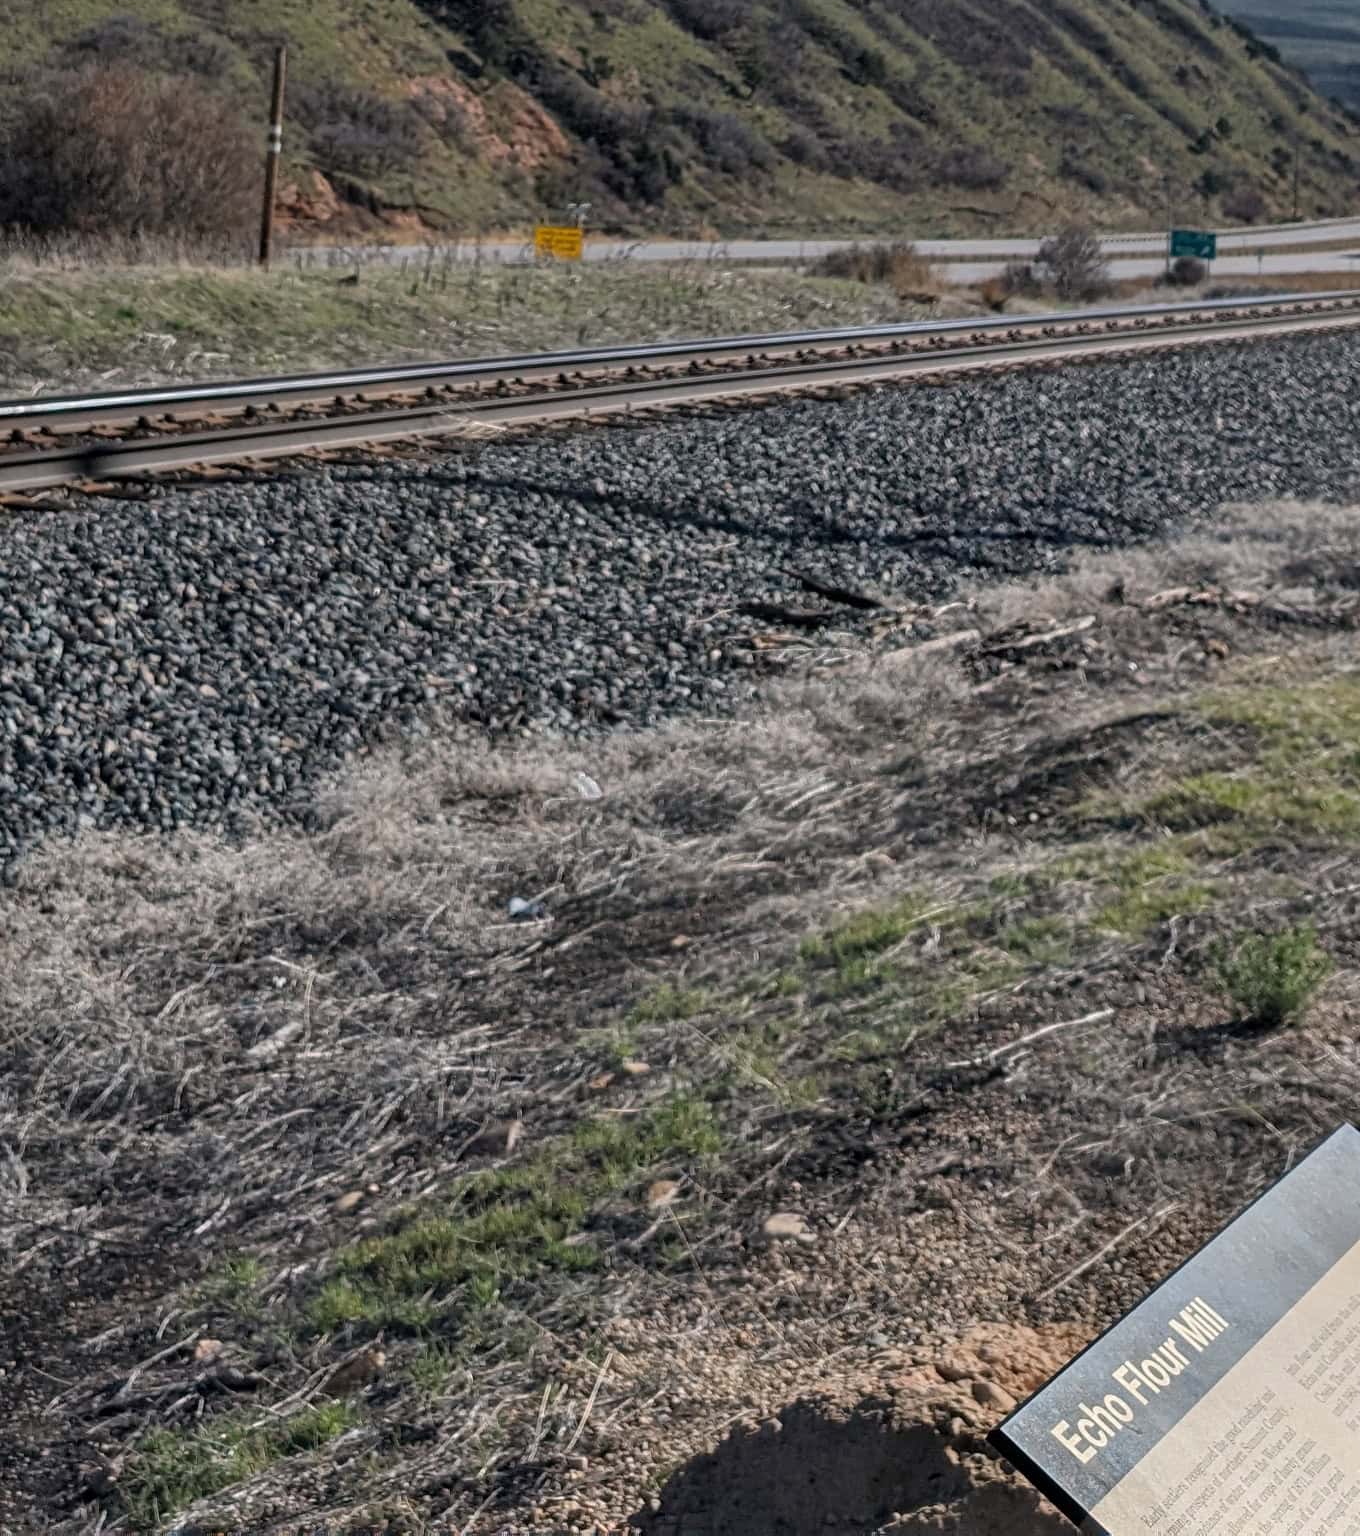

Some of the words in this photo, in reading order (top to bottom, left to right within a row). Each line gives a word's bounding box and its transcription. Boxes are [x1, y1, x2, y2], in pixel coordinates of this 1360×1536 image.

[1050, 1402, 1134, 1464] Echo
[1112, 1337, 1191, 1406] Flour
[1168, 1296, 1229, 1352] Mill
